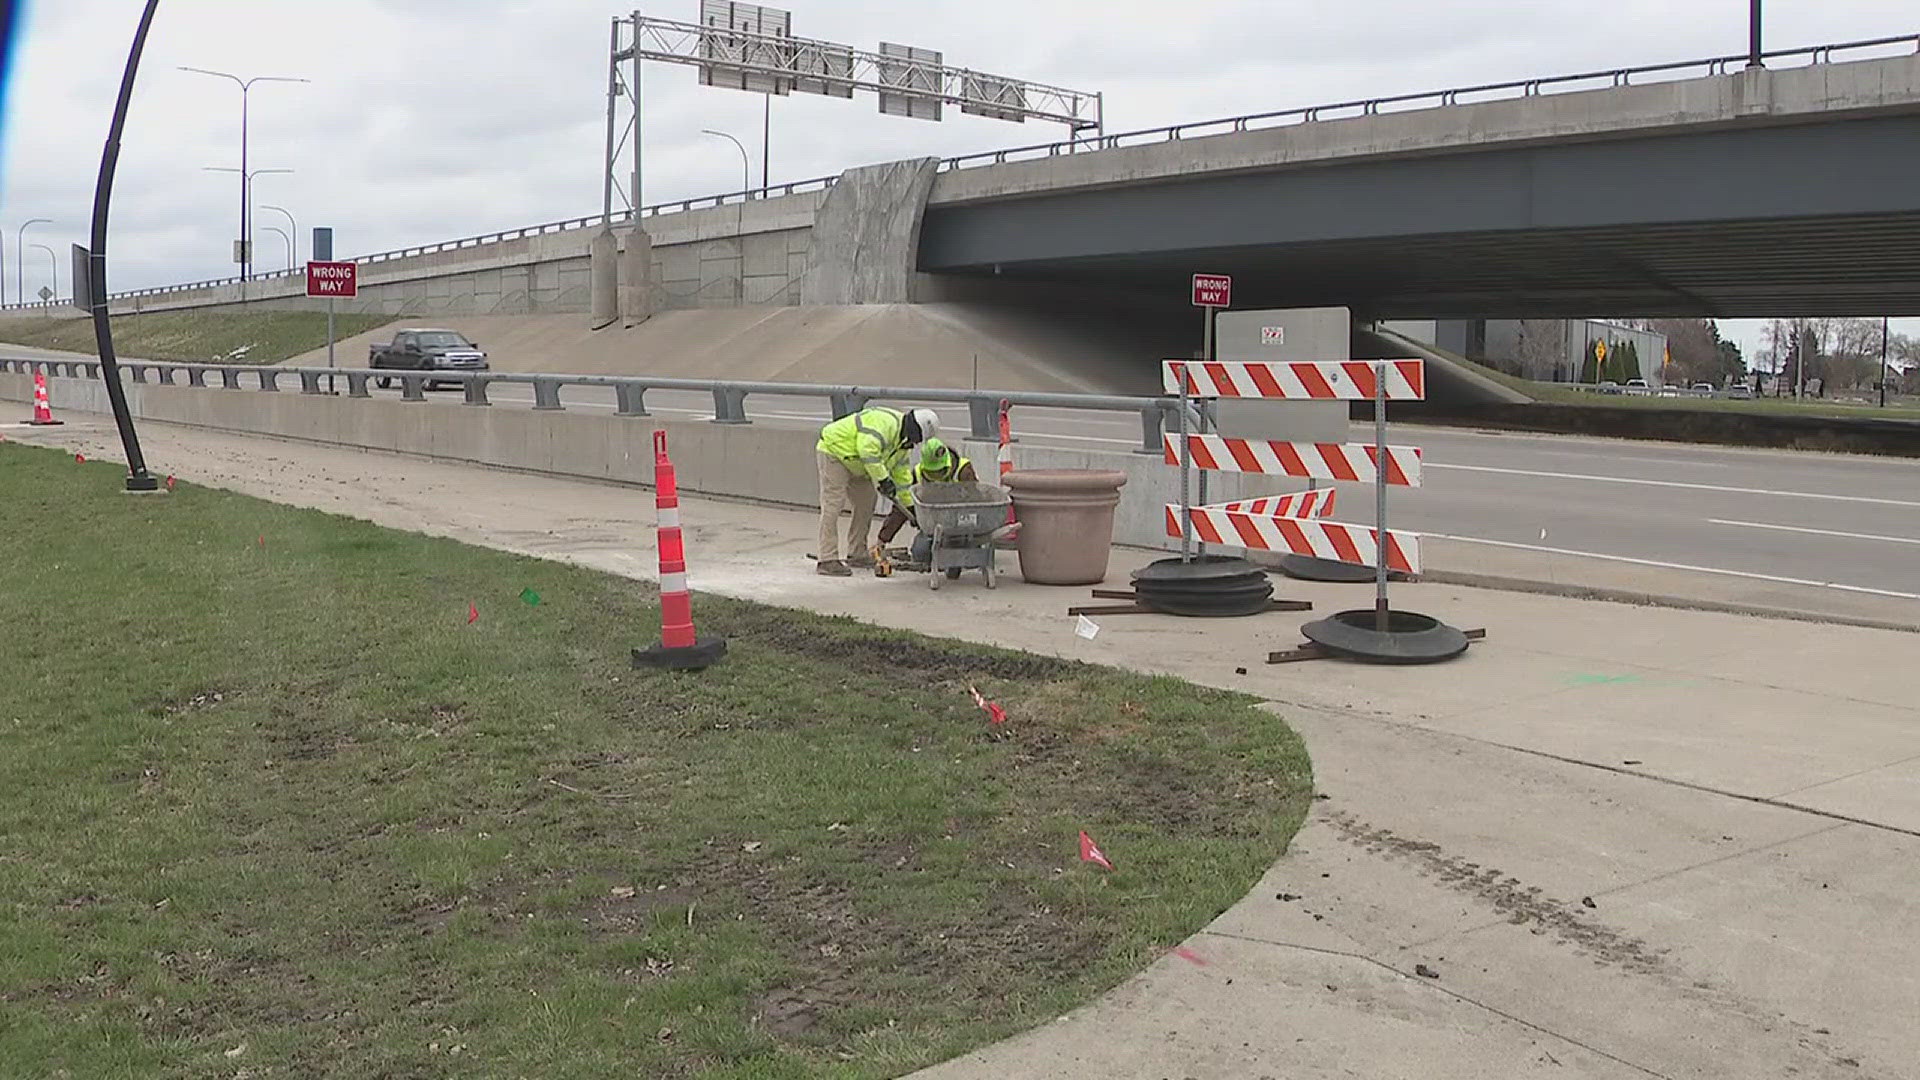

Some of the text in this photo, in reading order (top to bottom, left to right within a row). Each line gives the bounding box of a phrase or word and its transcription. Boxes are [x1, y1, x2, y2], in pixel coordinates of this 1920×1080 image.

[312, 266, 352, 279] WRONG
[319, 280, 344, 292] WAY
[1196, 279, 1228, 291] WRONG
[1201, 291, 1221, 303] WAY
